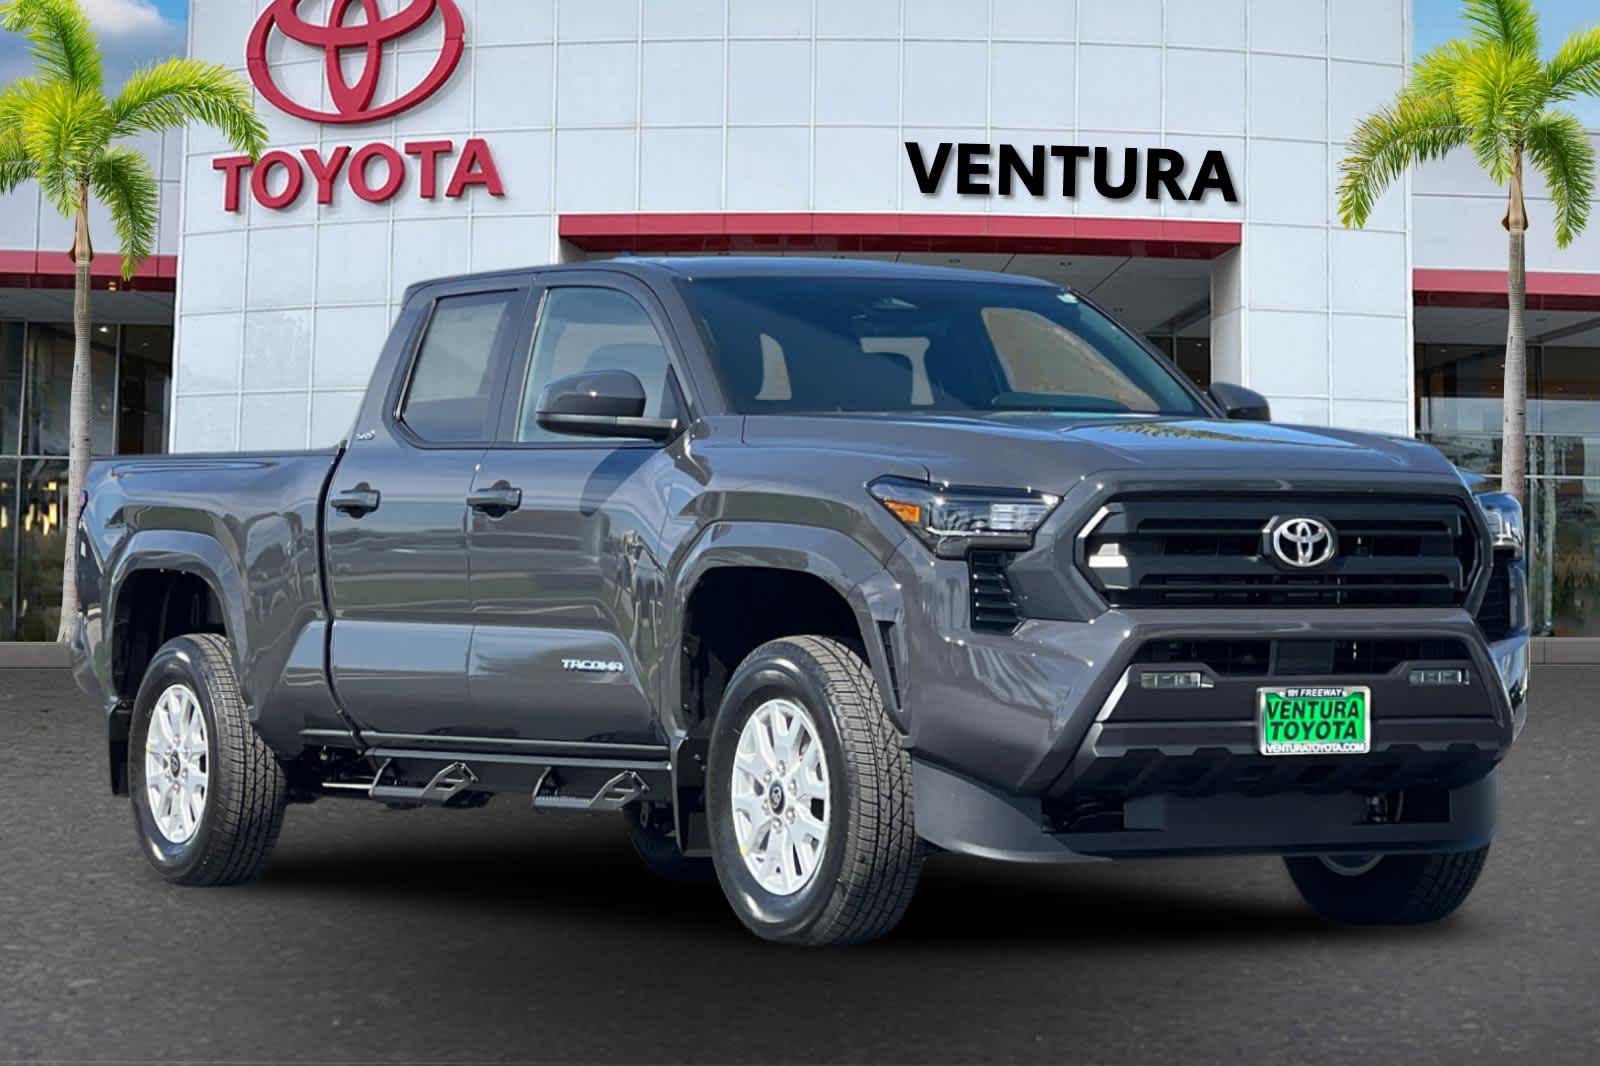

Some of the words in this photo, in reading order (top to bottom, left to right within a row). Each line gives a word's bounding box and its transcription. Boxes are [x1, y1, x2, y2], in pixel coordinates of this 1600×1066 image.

[212, 138, 505, 212] TOYOTA
[904, 142, 1238, 202] VENTURA
[1300, 688, 1342, 697] FREEWAY
[1266, 700, 1359, 719] VENTURA
[1270, 721, 1357, 740] TOYOTA
